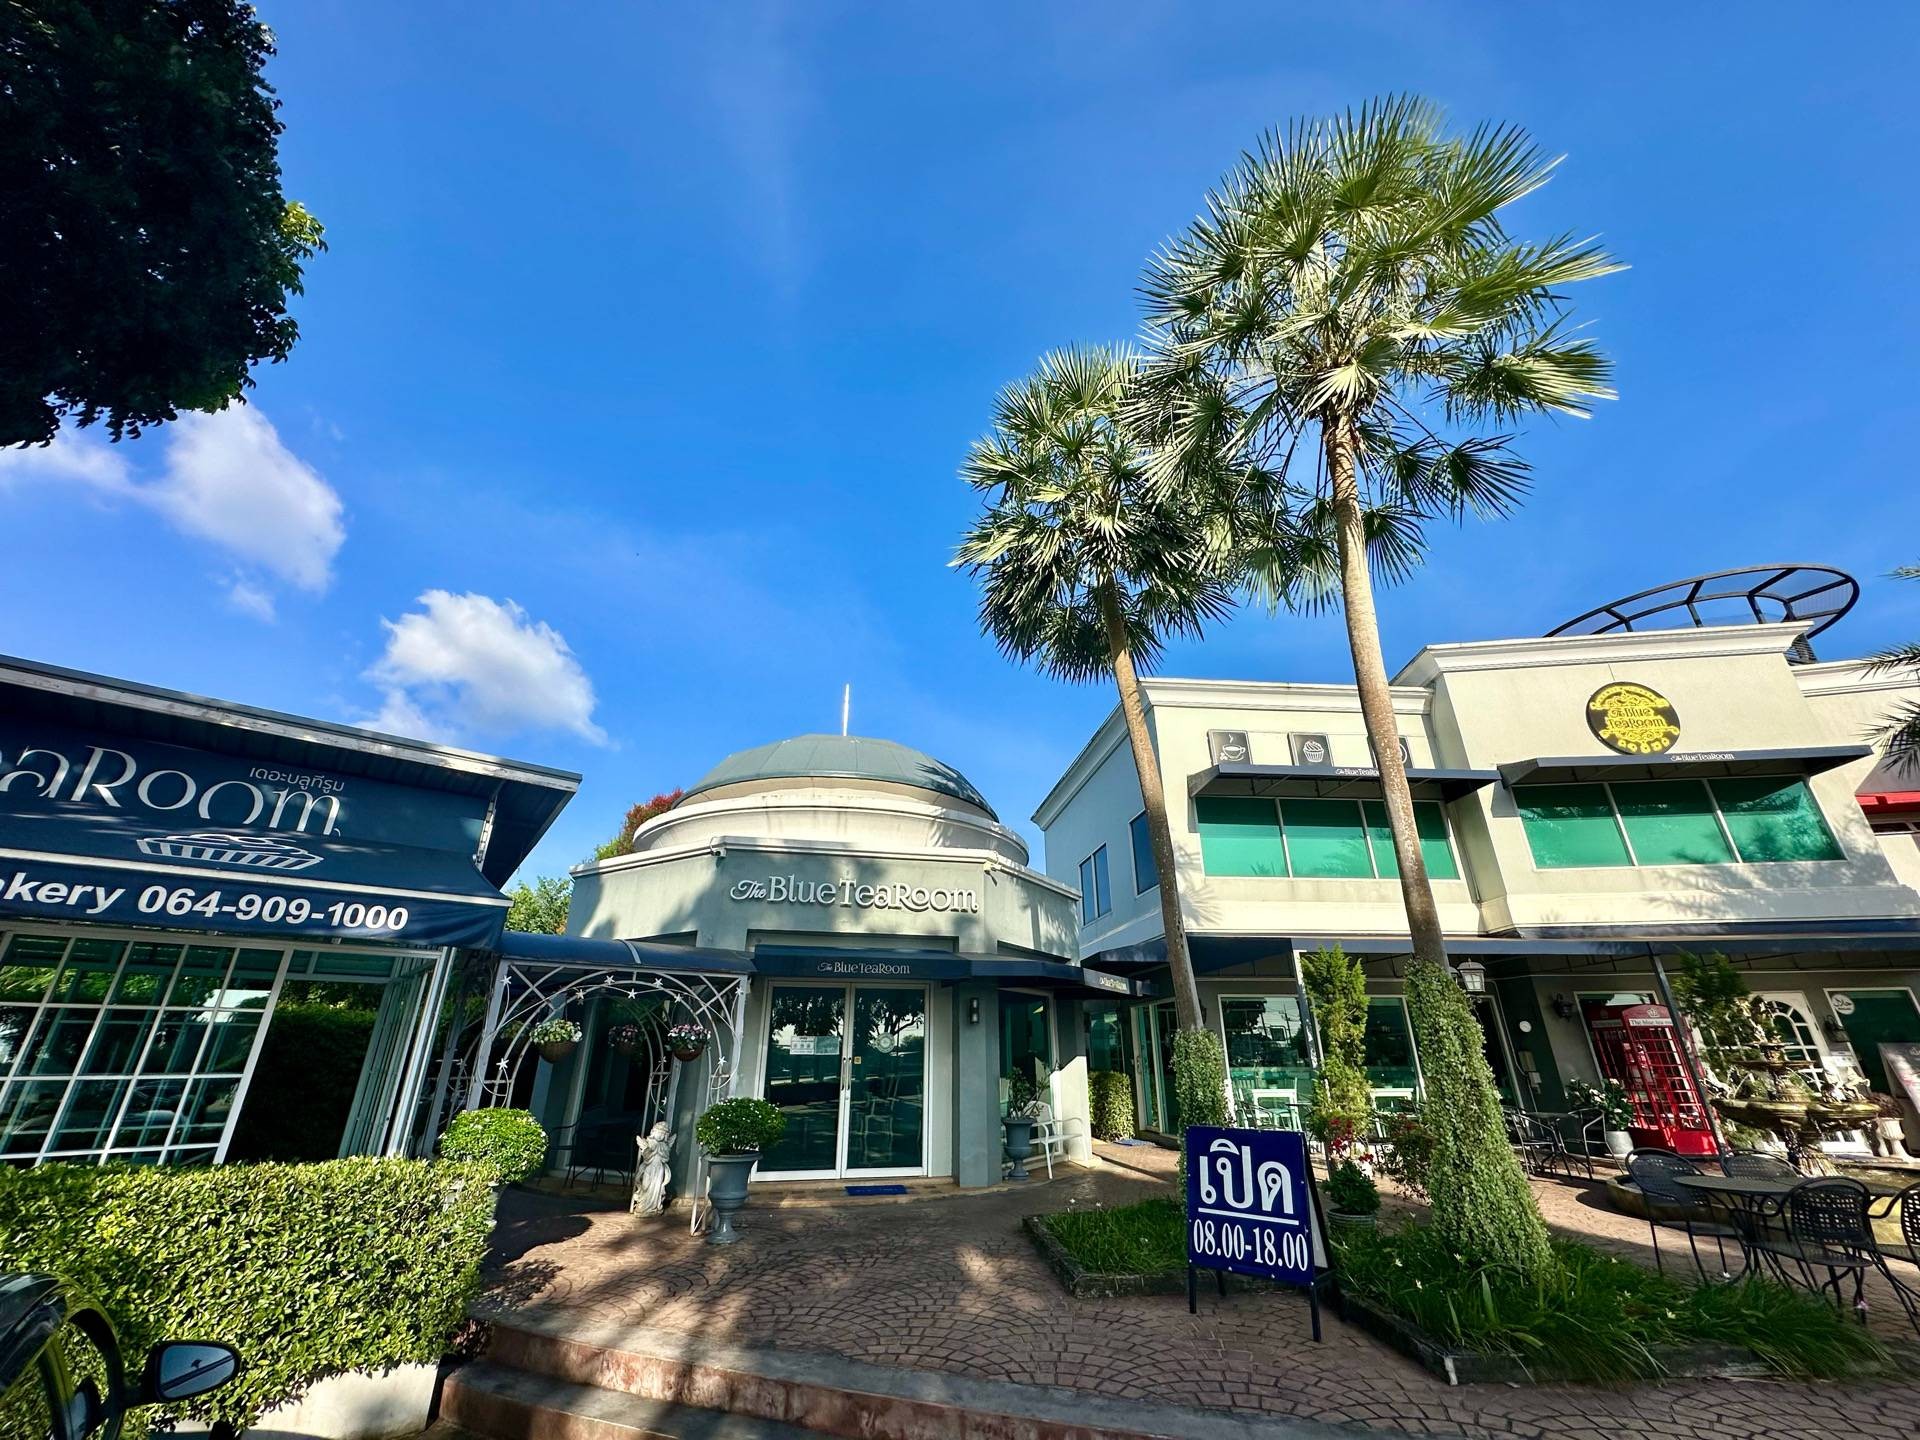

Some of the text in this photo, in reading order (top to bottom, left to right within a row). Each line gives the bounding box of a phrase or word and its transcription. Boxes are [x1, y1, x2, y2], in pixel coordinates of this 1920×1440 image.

[0, 745, 341, 837] aRoom
[249, 767, 345, 793] เดอะบลูทีรูม
[0, 872, 409, 931] kery 064-909-1000
[1199, 1138, 1294, 1215] เปิด
[1193, 1219, 1309, 1272] 08.00-18.00
